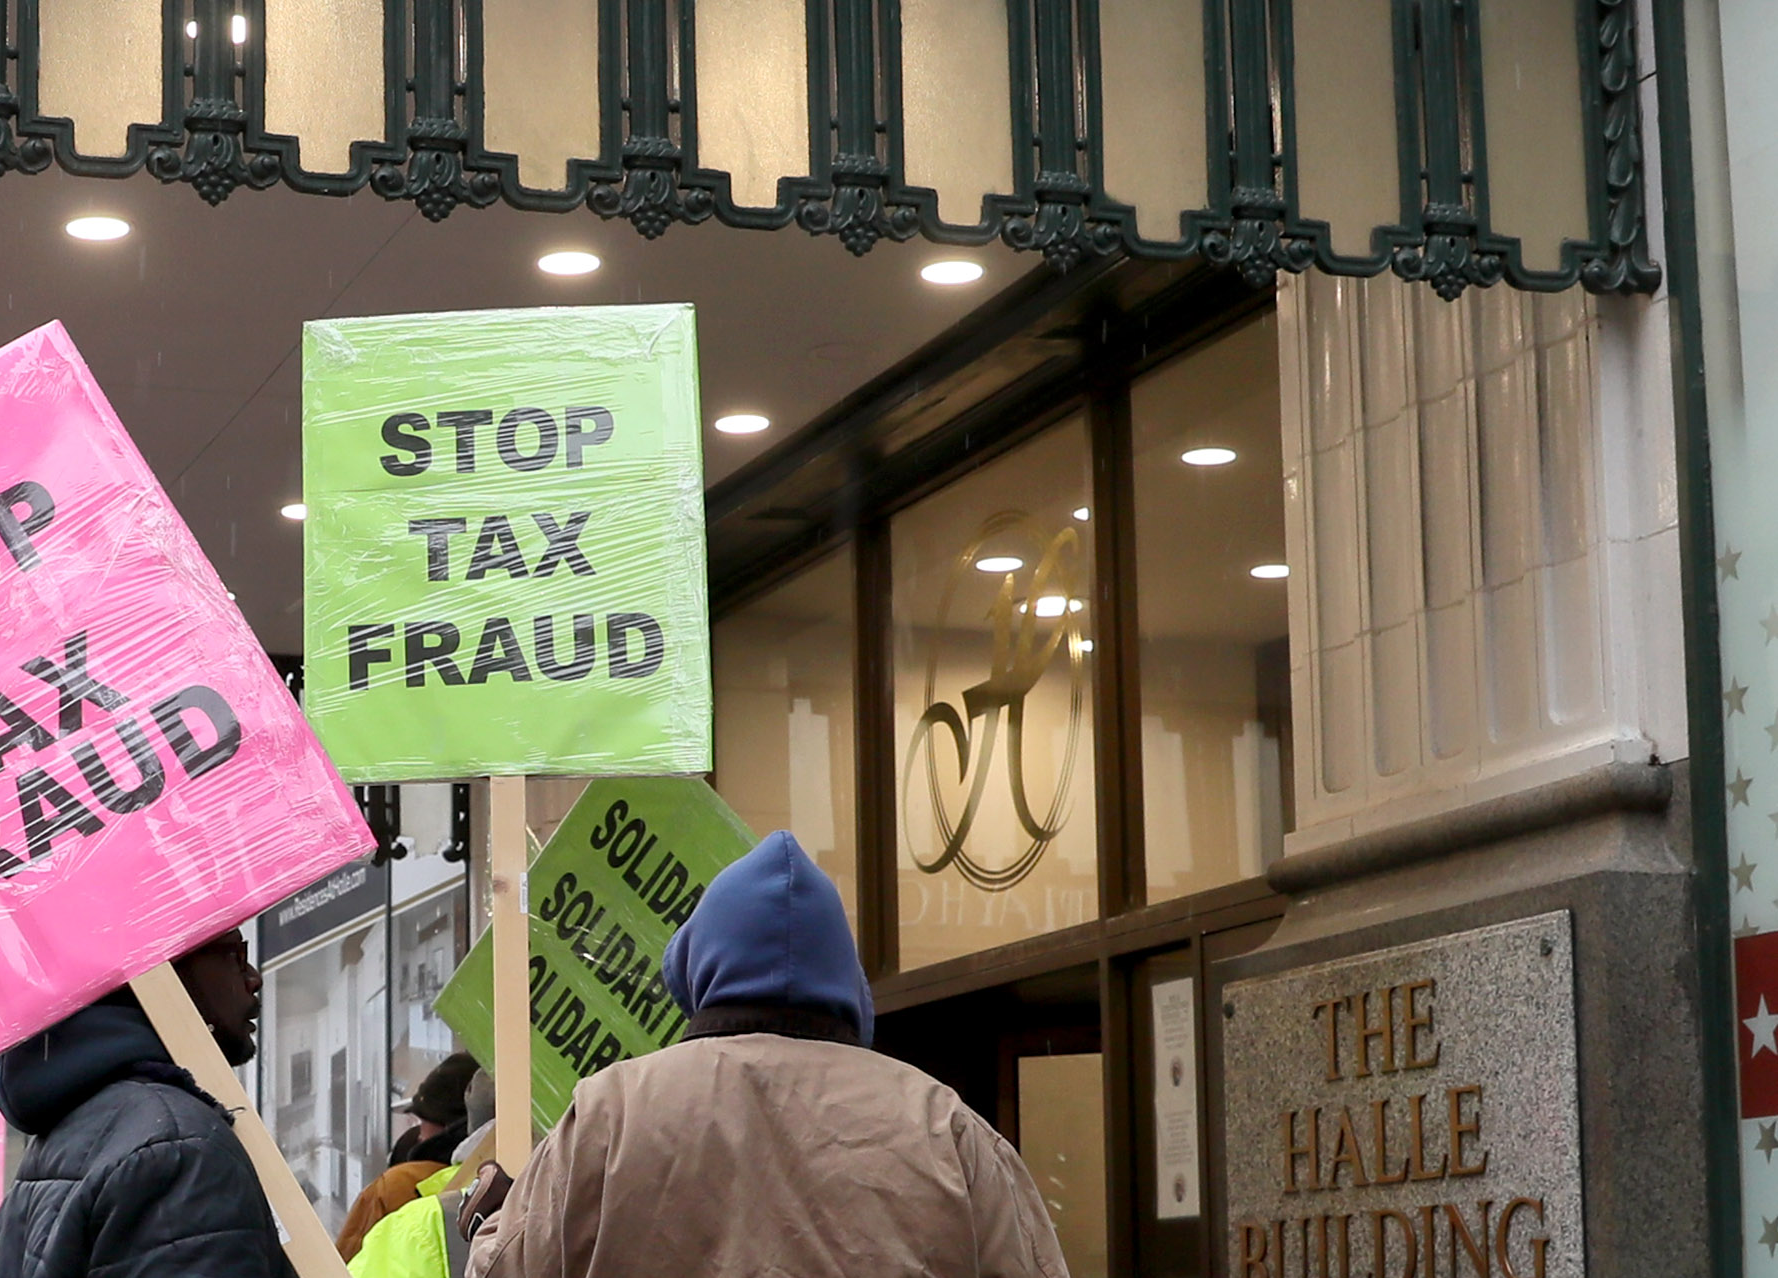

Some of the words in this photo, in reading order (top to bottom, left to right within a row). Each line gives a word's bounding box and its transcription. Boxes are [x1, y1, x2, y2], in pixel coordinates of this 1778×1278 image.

[379, 405, 615, 477] STOP
[408, 511, 598, 582] TAX
[347, 612, 666, 692] FRAUD
[589, 799, 706, 930] SOLIDA
[528, 953, 633, 1079] OLIDAR
[1312, 977, 1442, 1084] THE
[1281, 1083, 1489, 1194] HALLE
